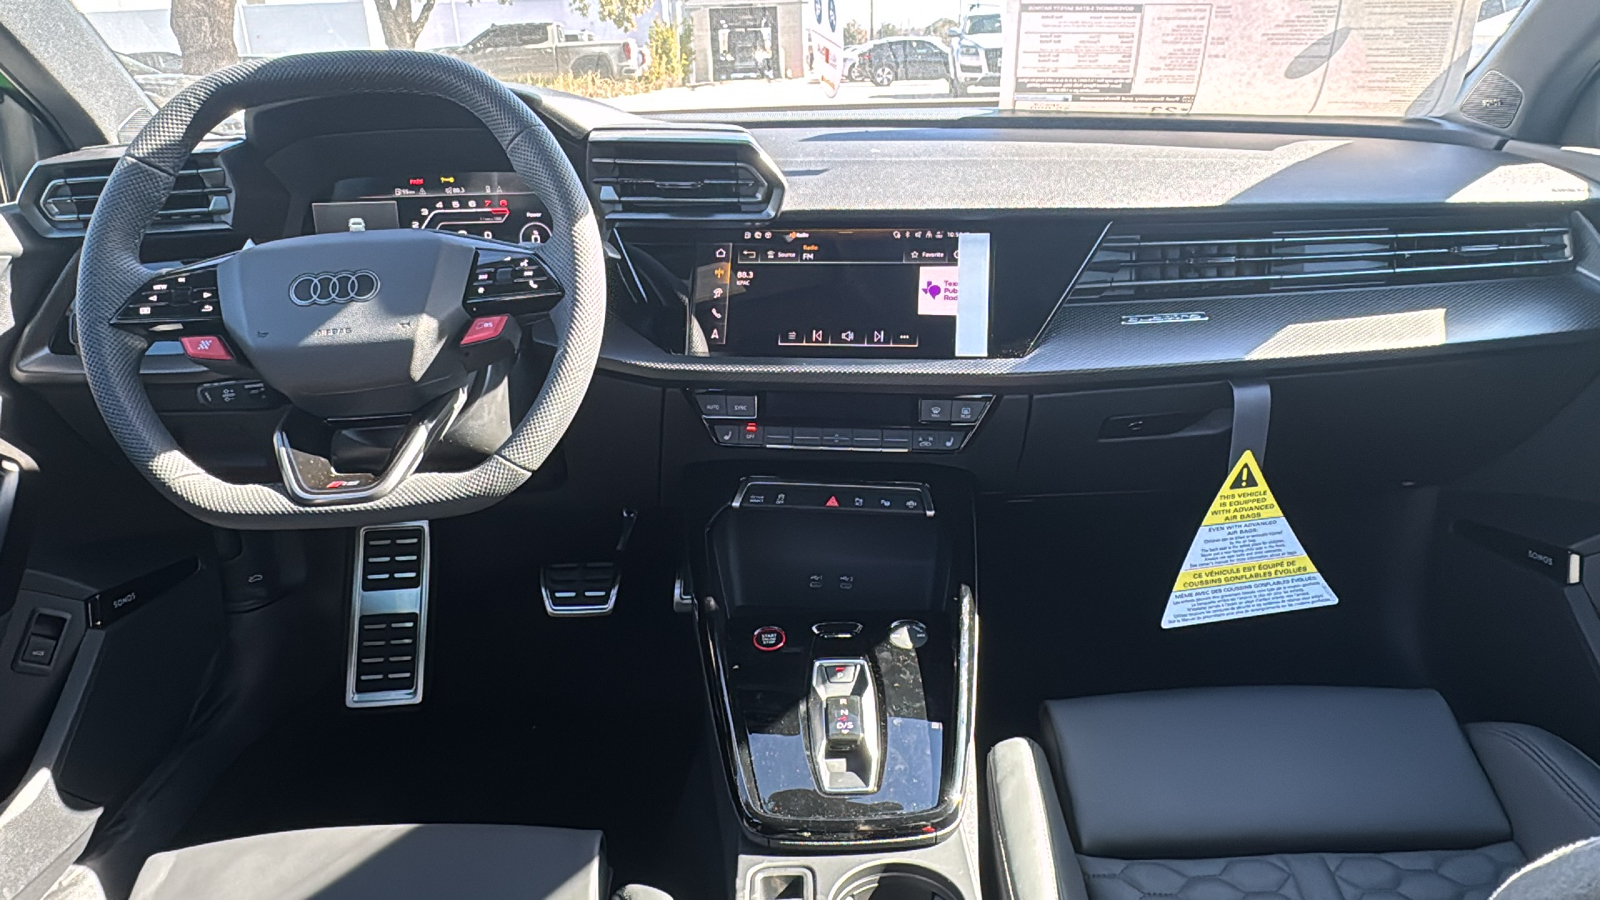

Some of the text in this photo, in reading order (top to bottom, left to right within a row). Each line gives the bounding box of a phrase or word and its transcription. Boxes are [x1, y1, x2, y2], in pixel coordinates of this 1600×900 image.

[737, 271, 754, 279] 88.3
[1238, 490, 1267, 498] VEHICLE
[1229, 498, 1267, 507] EQUIPPED
[1211, 504, 1275, 516] WITH ADVANCED
[1240, 512, 1261, 520] BAGS
[1208, 520, 1277, 533] EVEN WITH ADVANCED
[1528, 549, 1553, 565] SONOS
[1205, 567, 1241, 578] VÉHICULE
[1243, 565, 1256, 573] EST
[1258, 560, 1285, 571] ÉQUIPÉ
[1183, 566, 1307, 588] COUSSINS GONFLABLES ÉVOLUÉS
[113, 593, 136, 608] SONOS
